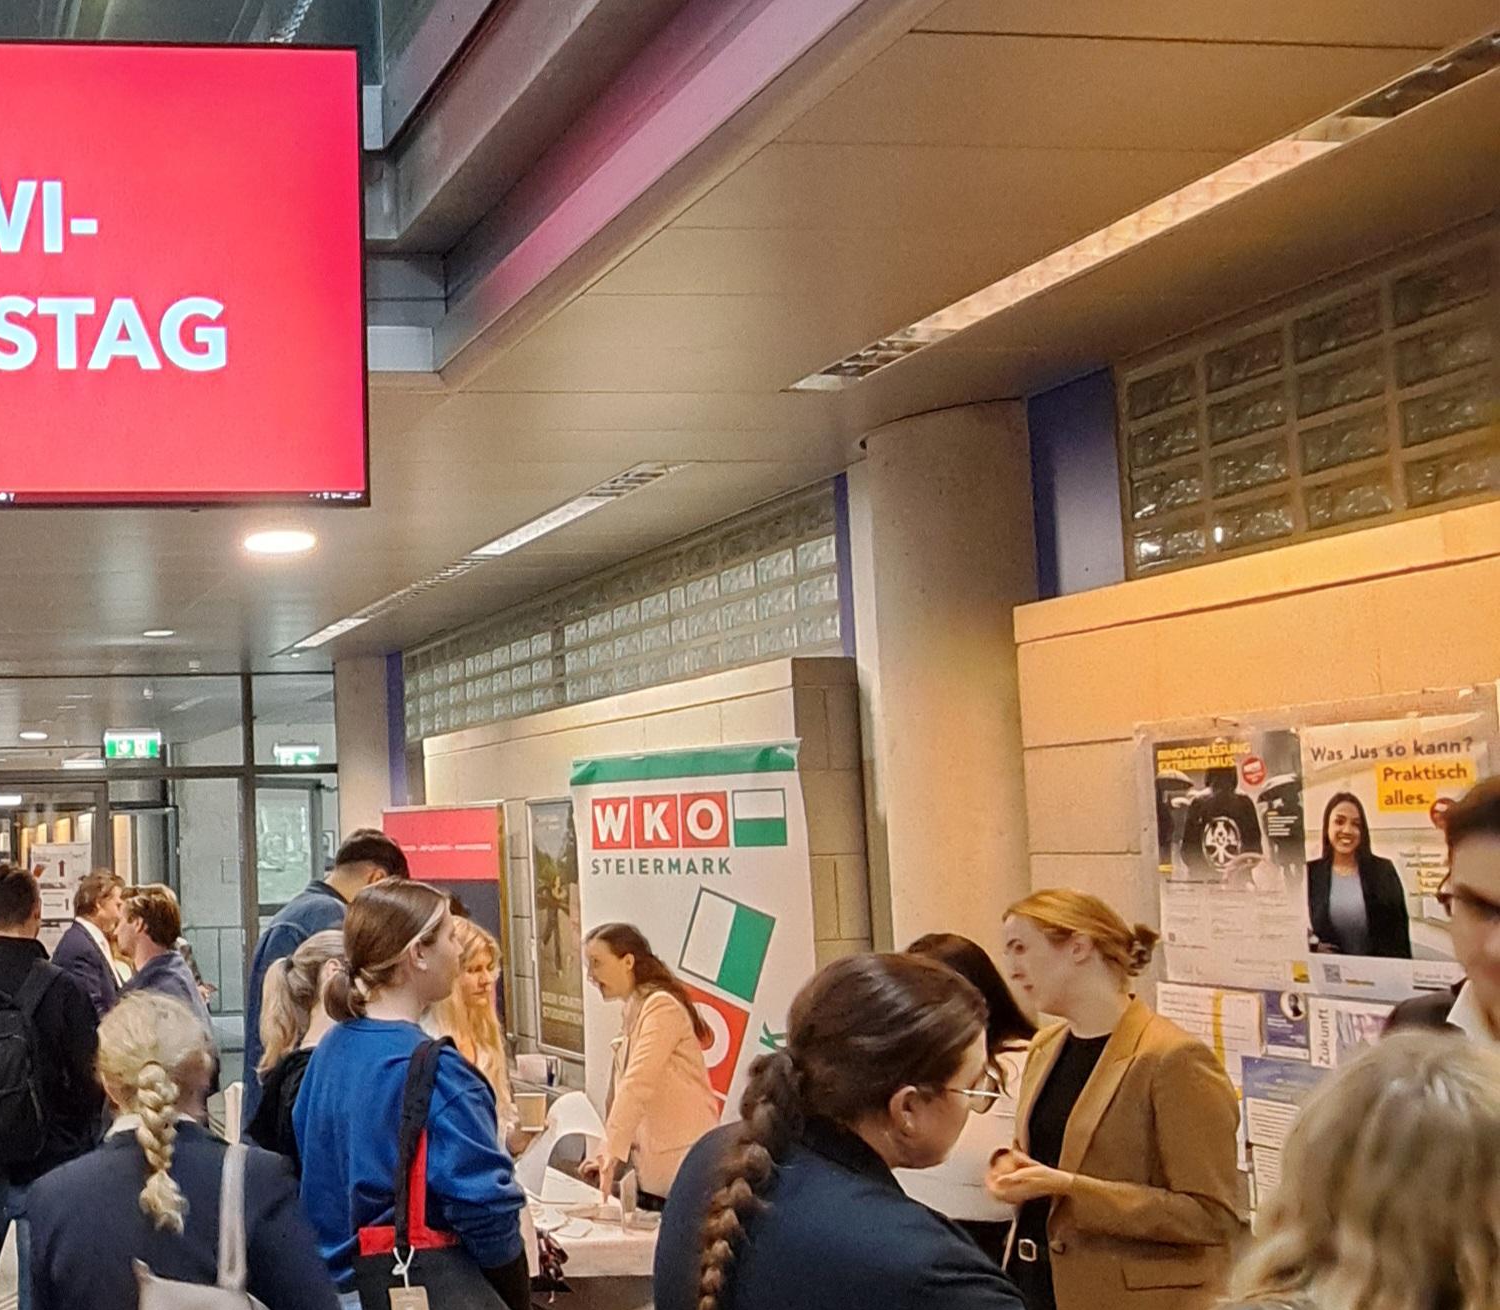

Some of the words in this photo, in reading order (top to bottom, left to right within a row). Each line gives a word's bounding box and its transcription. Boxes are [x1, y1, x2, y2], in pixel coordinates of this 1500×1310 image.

[1311, 746, 1344, 762] Was
[1351, 745, 1379, 760] Jus
[1386, 745, 1406, 757] so
[1413, 736, 1474, 755] kann?
[1383, 763, 1468, 782] Praktisch
[1384, 789, 1430, 806] alles.
[594, 798, 724, 843] WKO
[591, 857, 733, 875] STEIERMARK
[1317, 1008, 1331, 1066] Zukunft
